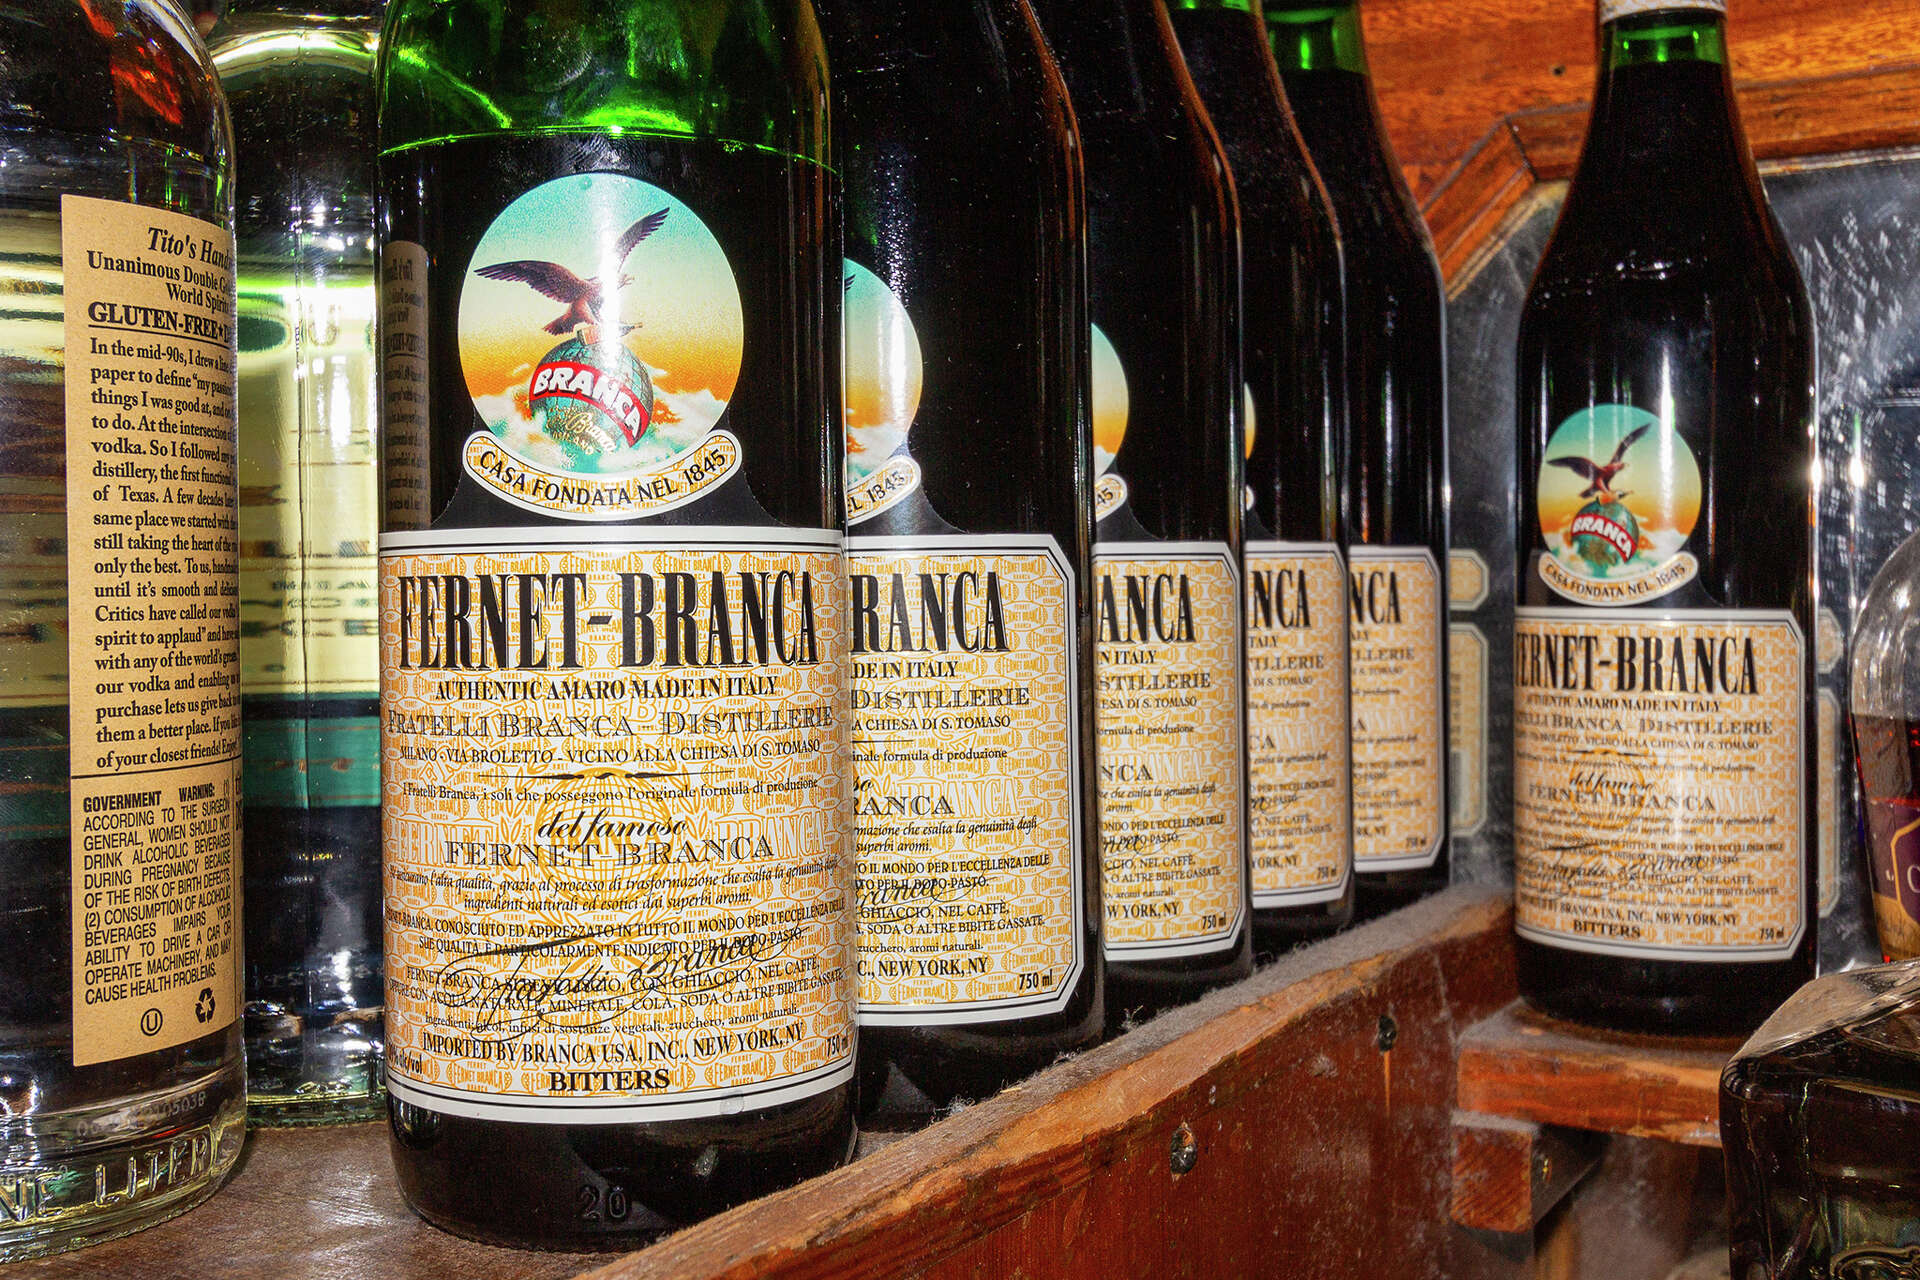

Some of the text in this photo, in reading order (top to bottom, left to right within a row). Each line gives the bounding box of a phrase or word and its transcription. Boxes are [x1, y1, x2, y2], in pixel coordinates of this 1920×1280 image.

[148, 227, 196, 259] Tito's
[87, 250, 218, 290] Unanimous Double
[166, 283, 202, 306] World
[91, 337, 214, 367] In the mid-90s, I drew
[91, 368, 135, 385] paper
[138, 370, 152, 383] to
[156, 369, 191, 387] define
[534, 367, 641, 440] BRANCA
[92, 437, 220, 462] vodka. So I followed
[480, 448, 725, 509] CASA FONDATA NEL 1845
[93, 485, 109, 501] of
[118, 486, 158, 502] Texas.
[163, 488, 173, 503] A
[177, 488, 194, 504] few
[197, 489, 224, 506] decades
[94, 510, 230, 531] same place we started with
[1574, 516, 1632, 555] BRANCA
[95, 581, 131, 597] until
[162, 581, 200, 597] smooth
[204, 583, 218, 596] and
[1544, 563, 1686, 596] CASA FONDATA NEL 1845
[96, 603, 221, 621] Critics have called our
[398, 570, 820, 671] FERNET-BRANCA
[849, 571, 1010, 654] RANCA
[1098, 573, 1198, 644] ANCA
[882, 661, 958, 677] IN ITALY
[1116, 650, 1156, 664] ITALY
[436, 676, 777, 700] AUTHENTIC AMARO MADE IN ITALY
[1097, 672, 1211, 690] STILLERIE
[96, 696, 218, 724] purchase lets us give
[851, 688, 1029, 710] DISTILLERIE
[1578, 697, 1718, 712] AMARO MADE IN ITALY
[389, 706, 833, 737] FRATELLI BRANCA DISTILLERIE
[866, 715, 1010, 730] CHIESA DI S. TOMASO
[1552, 709, 1773, 735] BRANCA DISTILLERIE
[97, 740, 220, 771] of your closest friends!
[400, 739, 820, 763] MILANO VIA BROLETTO VICINO ALLA CHIESA DI S. TOMASO
[884, 749, 1007, 762] formula di produzione
[83, 783, 215, 813] GOVERNMENT WARNING:
[84, 798, 230, 832] ACCORDING TO THE SURGEON
[538, 807, 688, 845] del famoso
[84, 814, 230, 851] GENERAL, WOMEN SHOULD NOT
[85, 832, 230, 870] DRINK ALCOHOLIC BEVERAGES
[856, 840, 932, 858] superbi aromi.
[1285, 855, 1297, 866] NY
[85, 850, 230, 889] DURING PREGNANCY BECAUSE
[464, 891, 752, 914] ingredienti naturali ed esotici dai superbi aromi.
[1123, 902, 1178, 918] YORK, NY
[1203, 915, 1216, 929] 750
[1574, 920, 1640, 937] BITTERS
[1656, 912, 1736, 926] NEW YORK, NY
[879, 957, 987, 977] NEW YORK, NY
[85, 962, 216, 1005] CAUSE HEALTH PROBLEMS.
[1020, 969, 1052, 990] 750 ml
[423, 1022, 803, 1063] IMPORTED BY BRANCA USA, INC., NEW YORK, NY
[827, 1034, 840, 1056] 750
[549, 1069, 670, 1091] BITTERS
